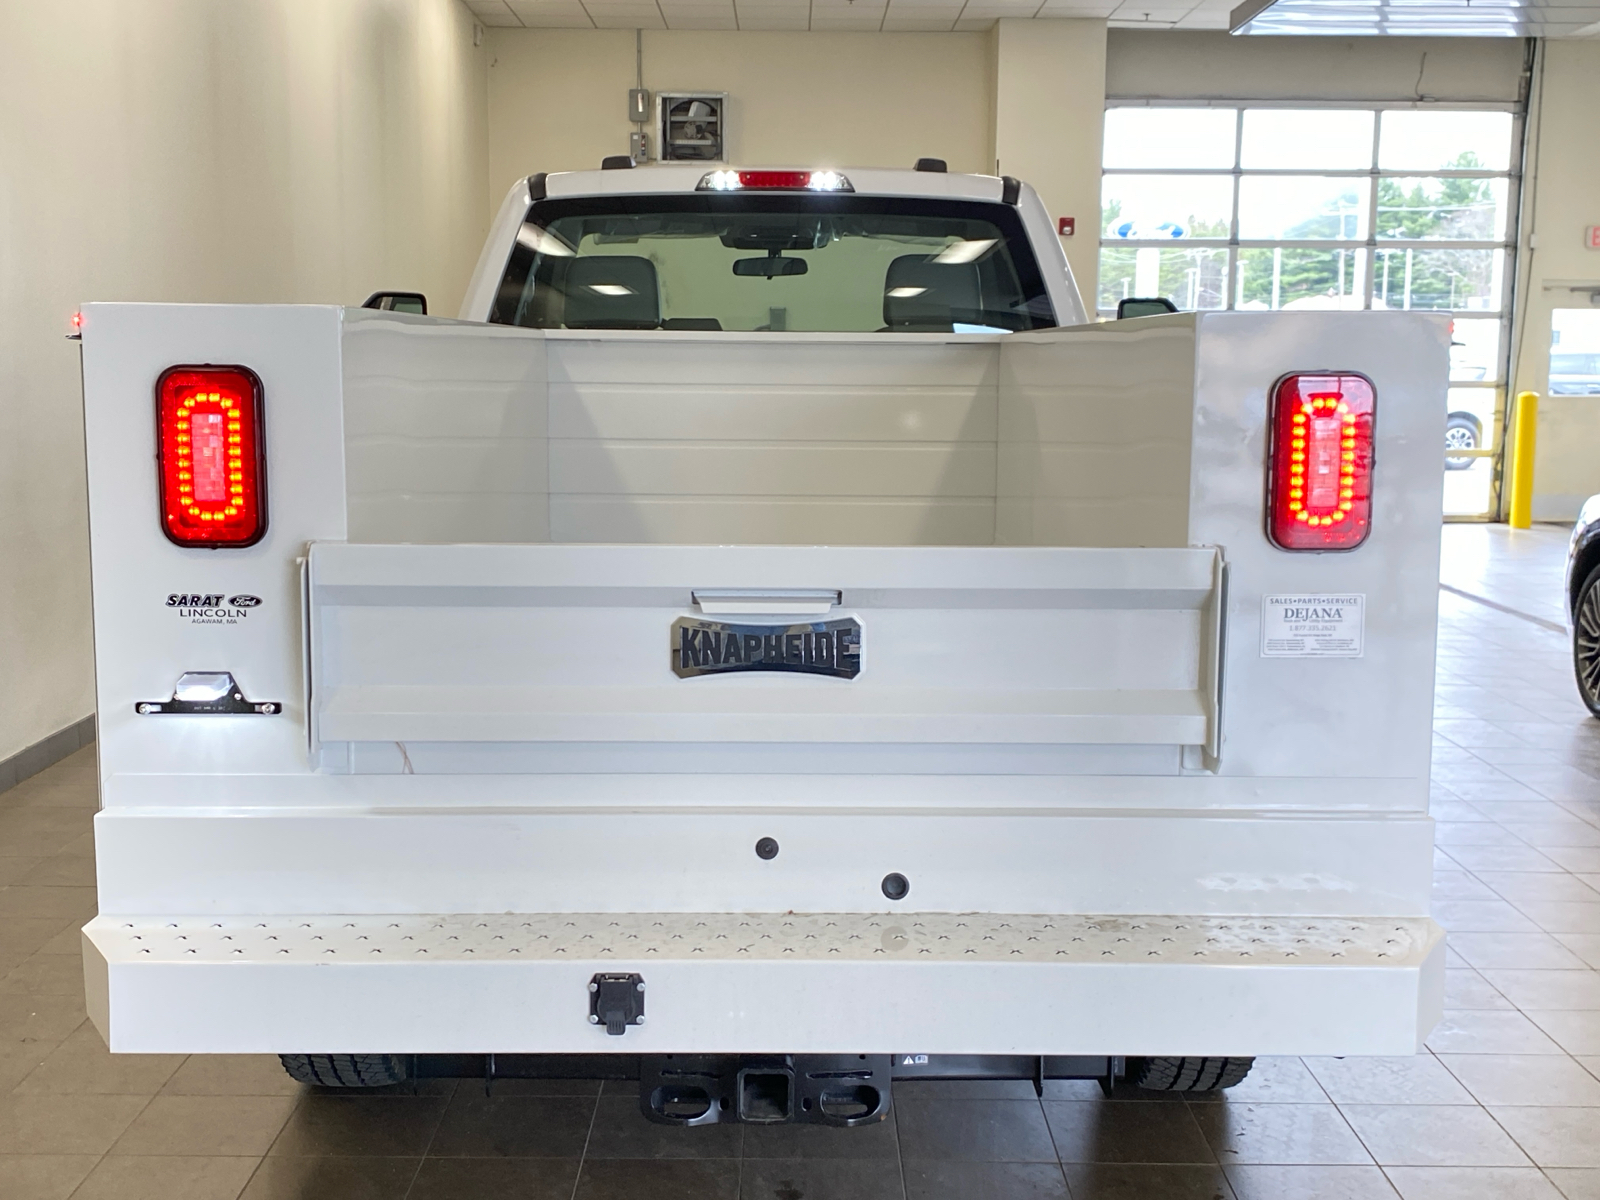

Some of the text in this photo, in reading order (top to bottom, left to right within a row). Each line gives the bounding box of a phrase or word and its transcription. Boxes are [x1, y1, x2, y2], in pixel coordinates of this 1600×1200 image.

[165, 593, 259, 608] SARAT Ford
[179, 608, 247, 618] LINCOLN
[1283, 607, 1343, 622] DEJANA
[680, 625, 852, 671] KNAPHEIDE
